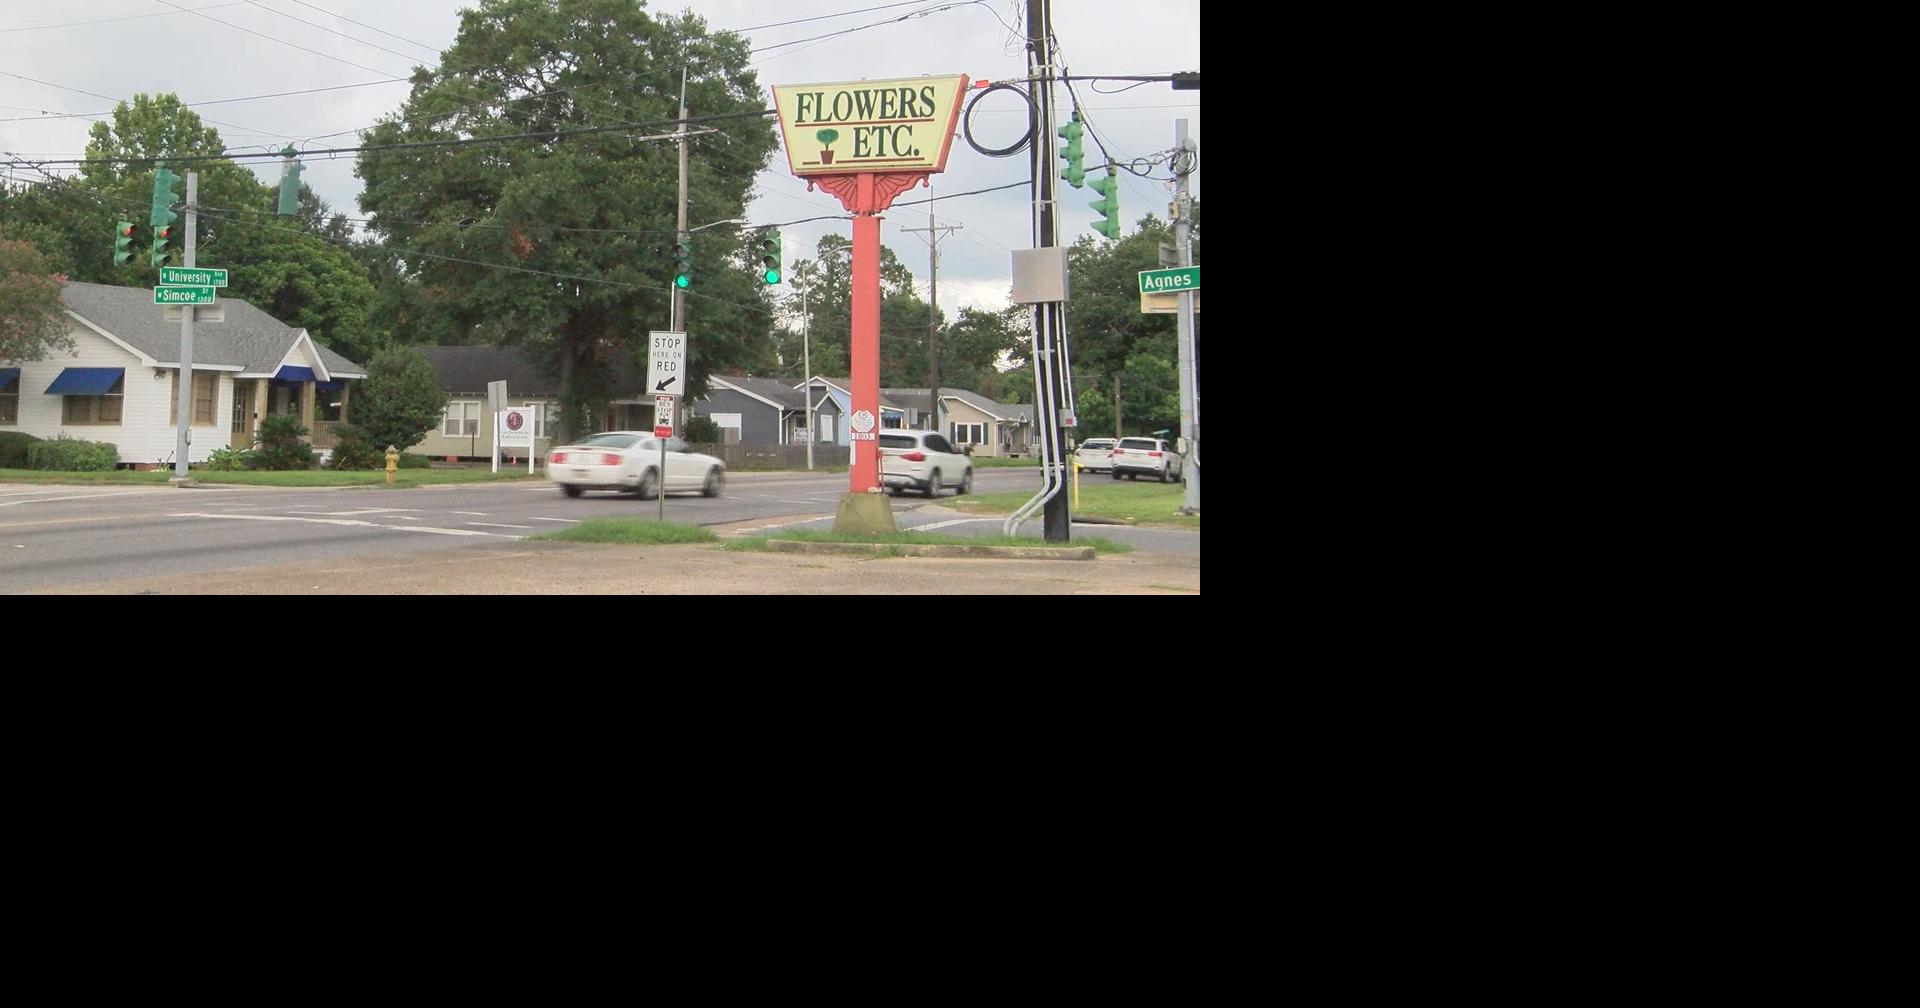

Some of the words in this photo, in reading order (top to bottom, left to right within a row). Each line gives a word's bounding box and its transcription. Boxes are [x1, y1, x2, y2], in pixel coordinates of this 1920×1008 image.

[795, 86, 935, 123] FLOWERS
[853, 125, 920, 158] ETC.
[169, 270, 211, 284] University
[1144, 274, 1192, 291] Agnes
[163, 289, 196, 301] Simcoe
[654, 338, 681, 348] STOP
[657, 361, 677, 371] RED
